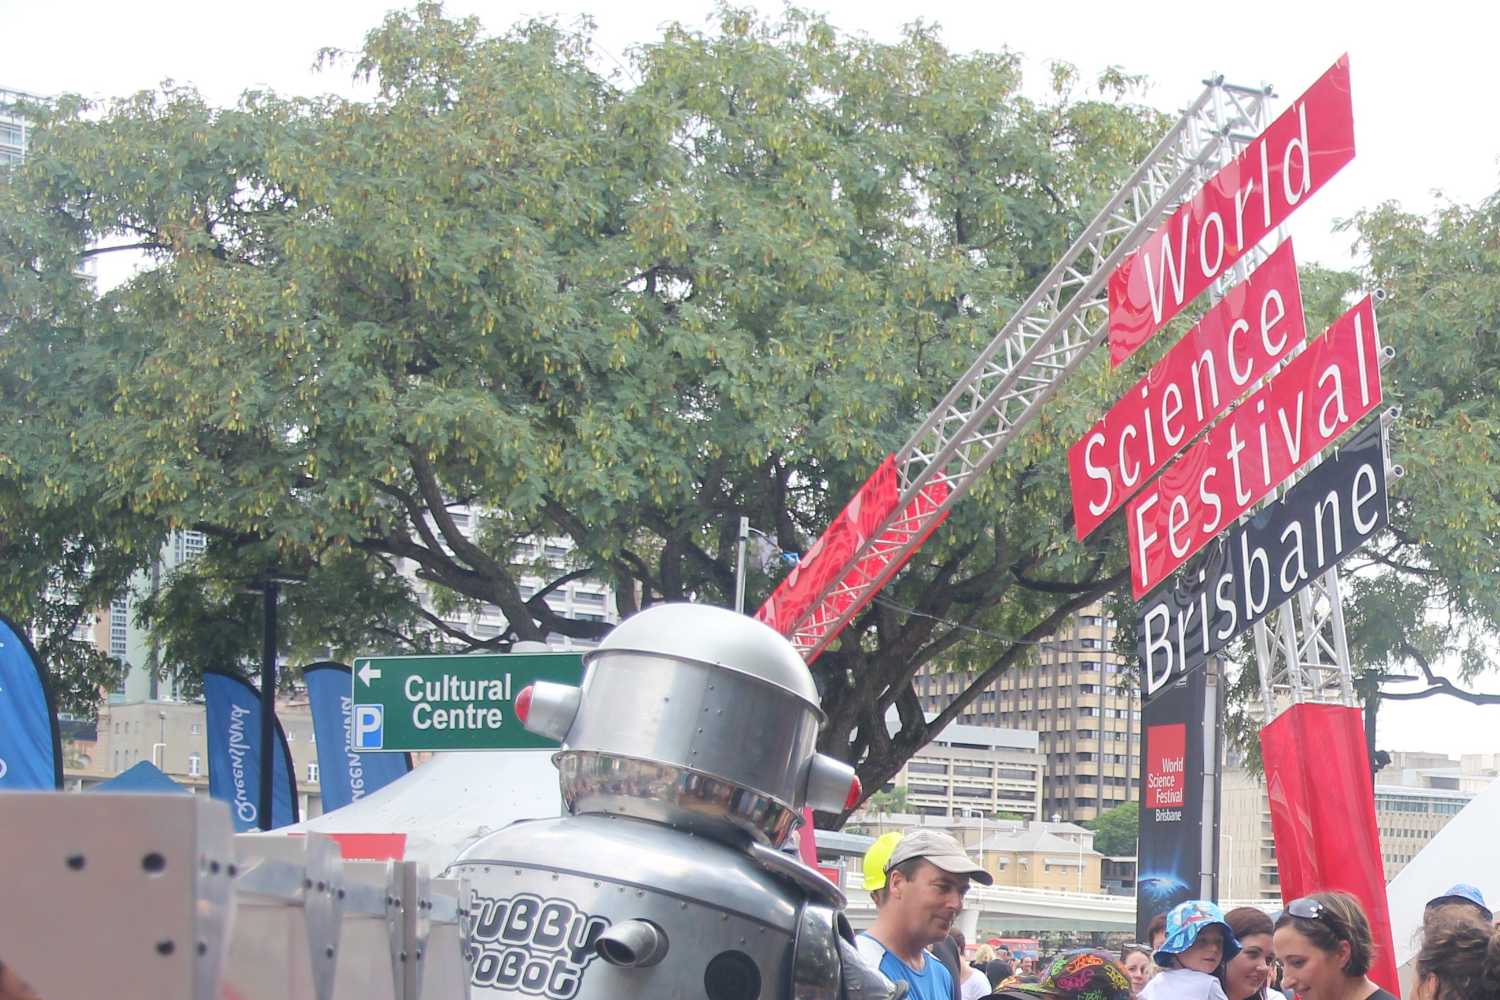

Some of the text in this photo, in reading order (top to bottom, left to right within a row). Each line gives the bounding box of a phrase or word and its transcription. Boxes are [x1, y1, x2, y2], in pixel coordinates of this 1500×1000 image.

[1143, 101, 1311, 324] World
[1084, 289, 1288, 516] Science
[1135, 312, 1370, 587] Festival
[1144, 463, 1379, 695] Brisbane
[404, 673, 512, 701] Cultural
[355, 707, 381, 747] P
[412, 703, 503, 730] Centre
[1162, 757, 1184, 773] World
[1148, 773, 1175, 788] Science
[1156, 788, 1183, 804] Festival
[1155, 808, 1182, 822] Brisbane
